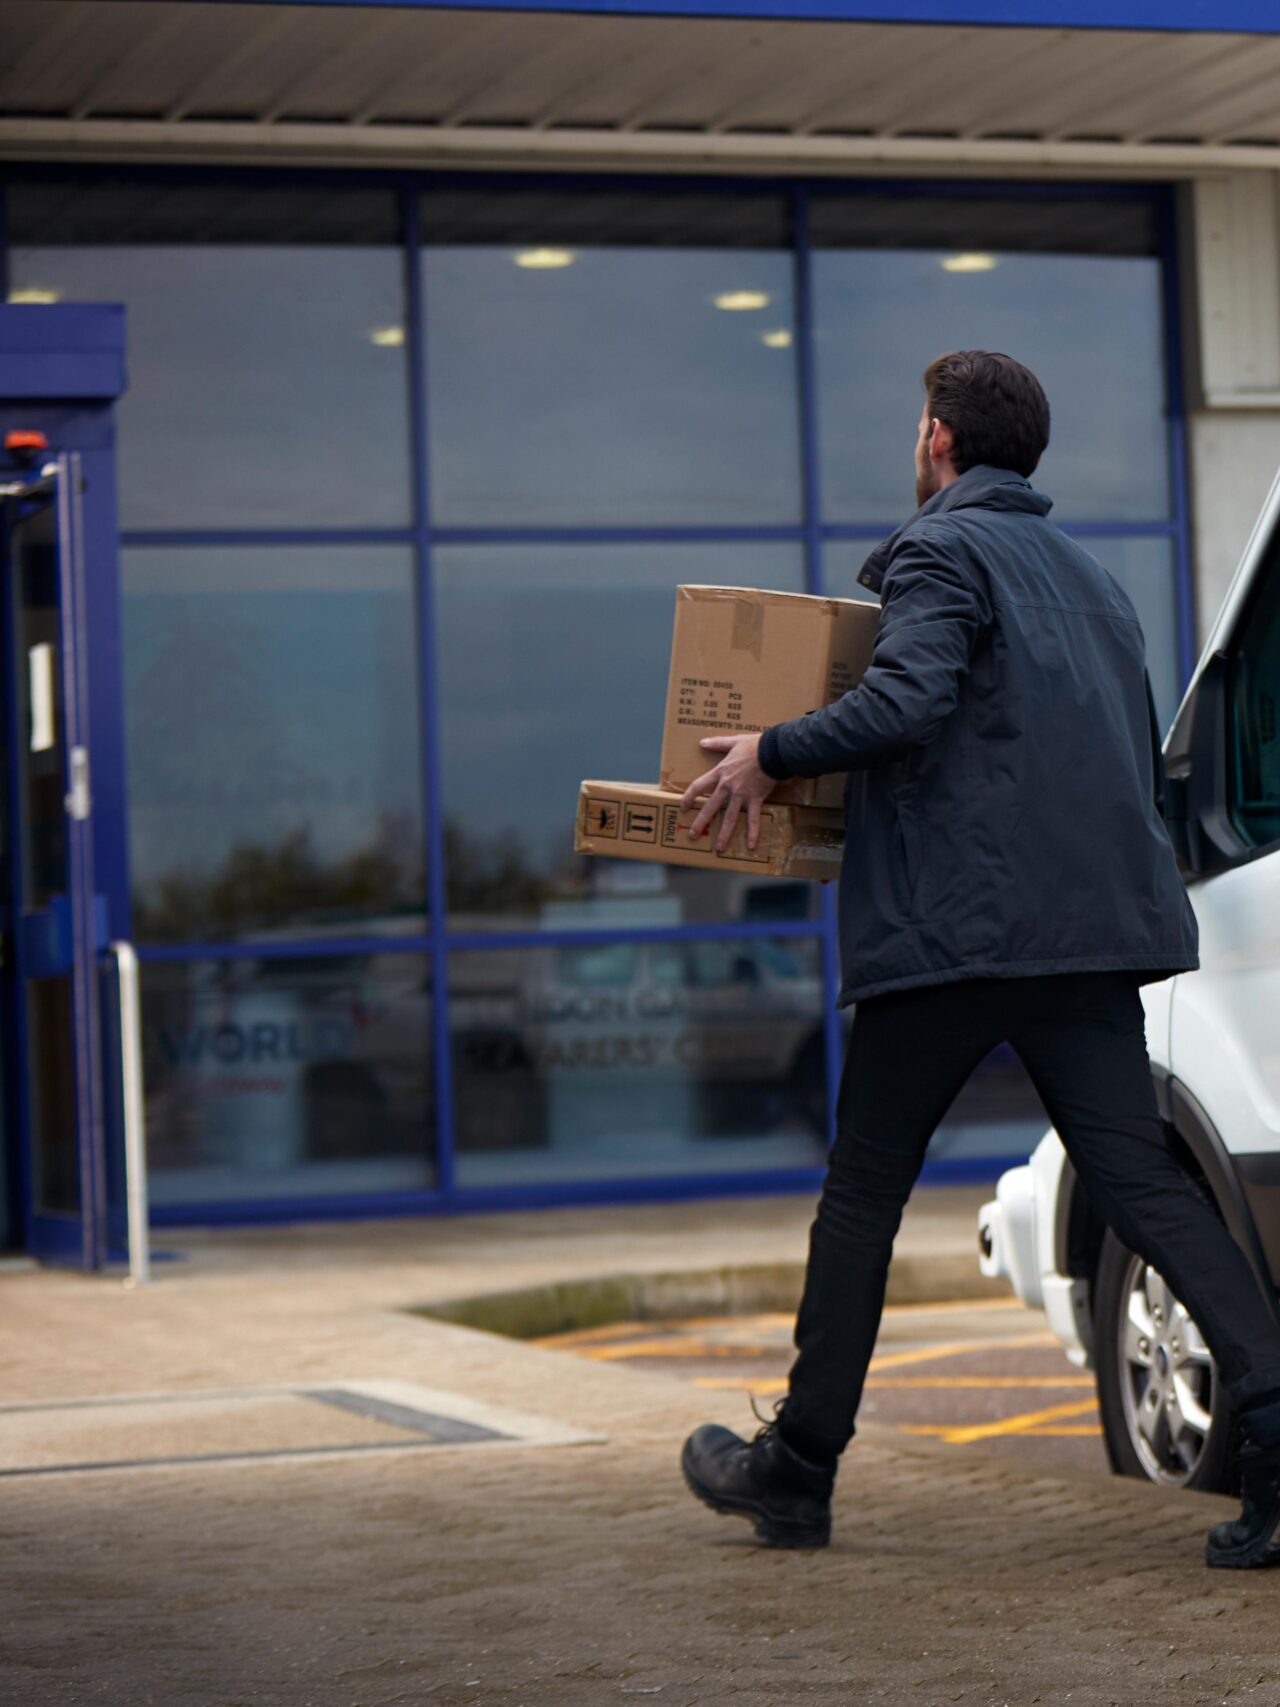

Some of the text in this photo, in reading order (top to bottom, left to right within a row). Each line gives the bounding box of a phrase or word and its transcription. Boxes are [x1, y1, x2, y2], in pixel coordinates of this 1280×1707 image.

[681, 678, 697, 686] ITEM
[728, 692, 742, 700] PCS
[728, 702, 742, 710] KGS
[726, 712, 741, 720] KGS
[664, 810, 678, 843] FRAGILE
